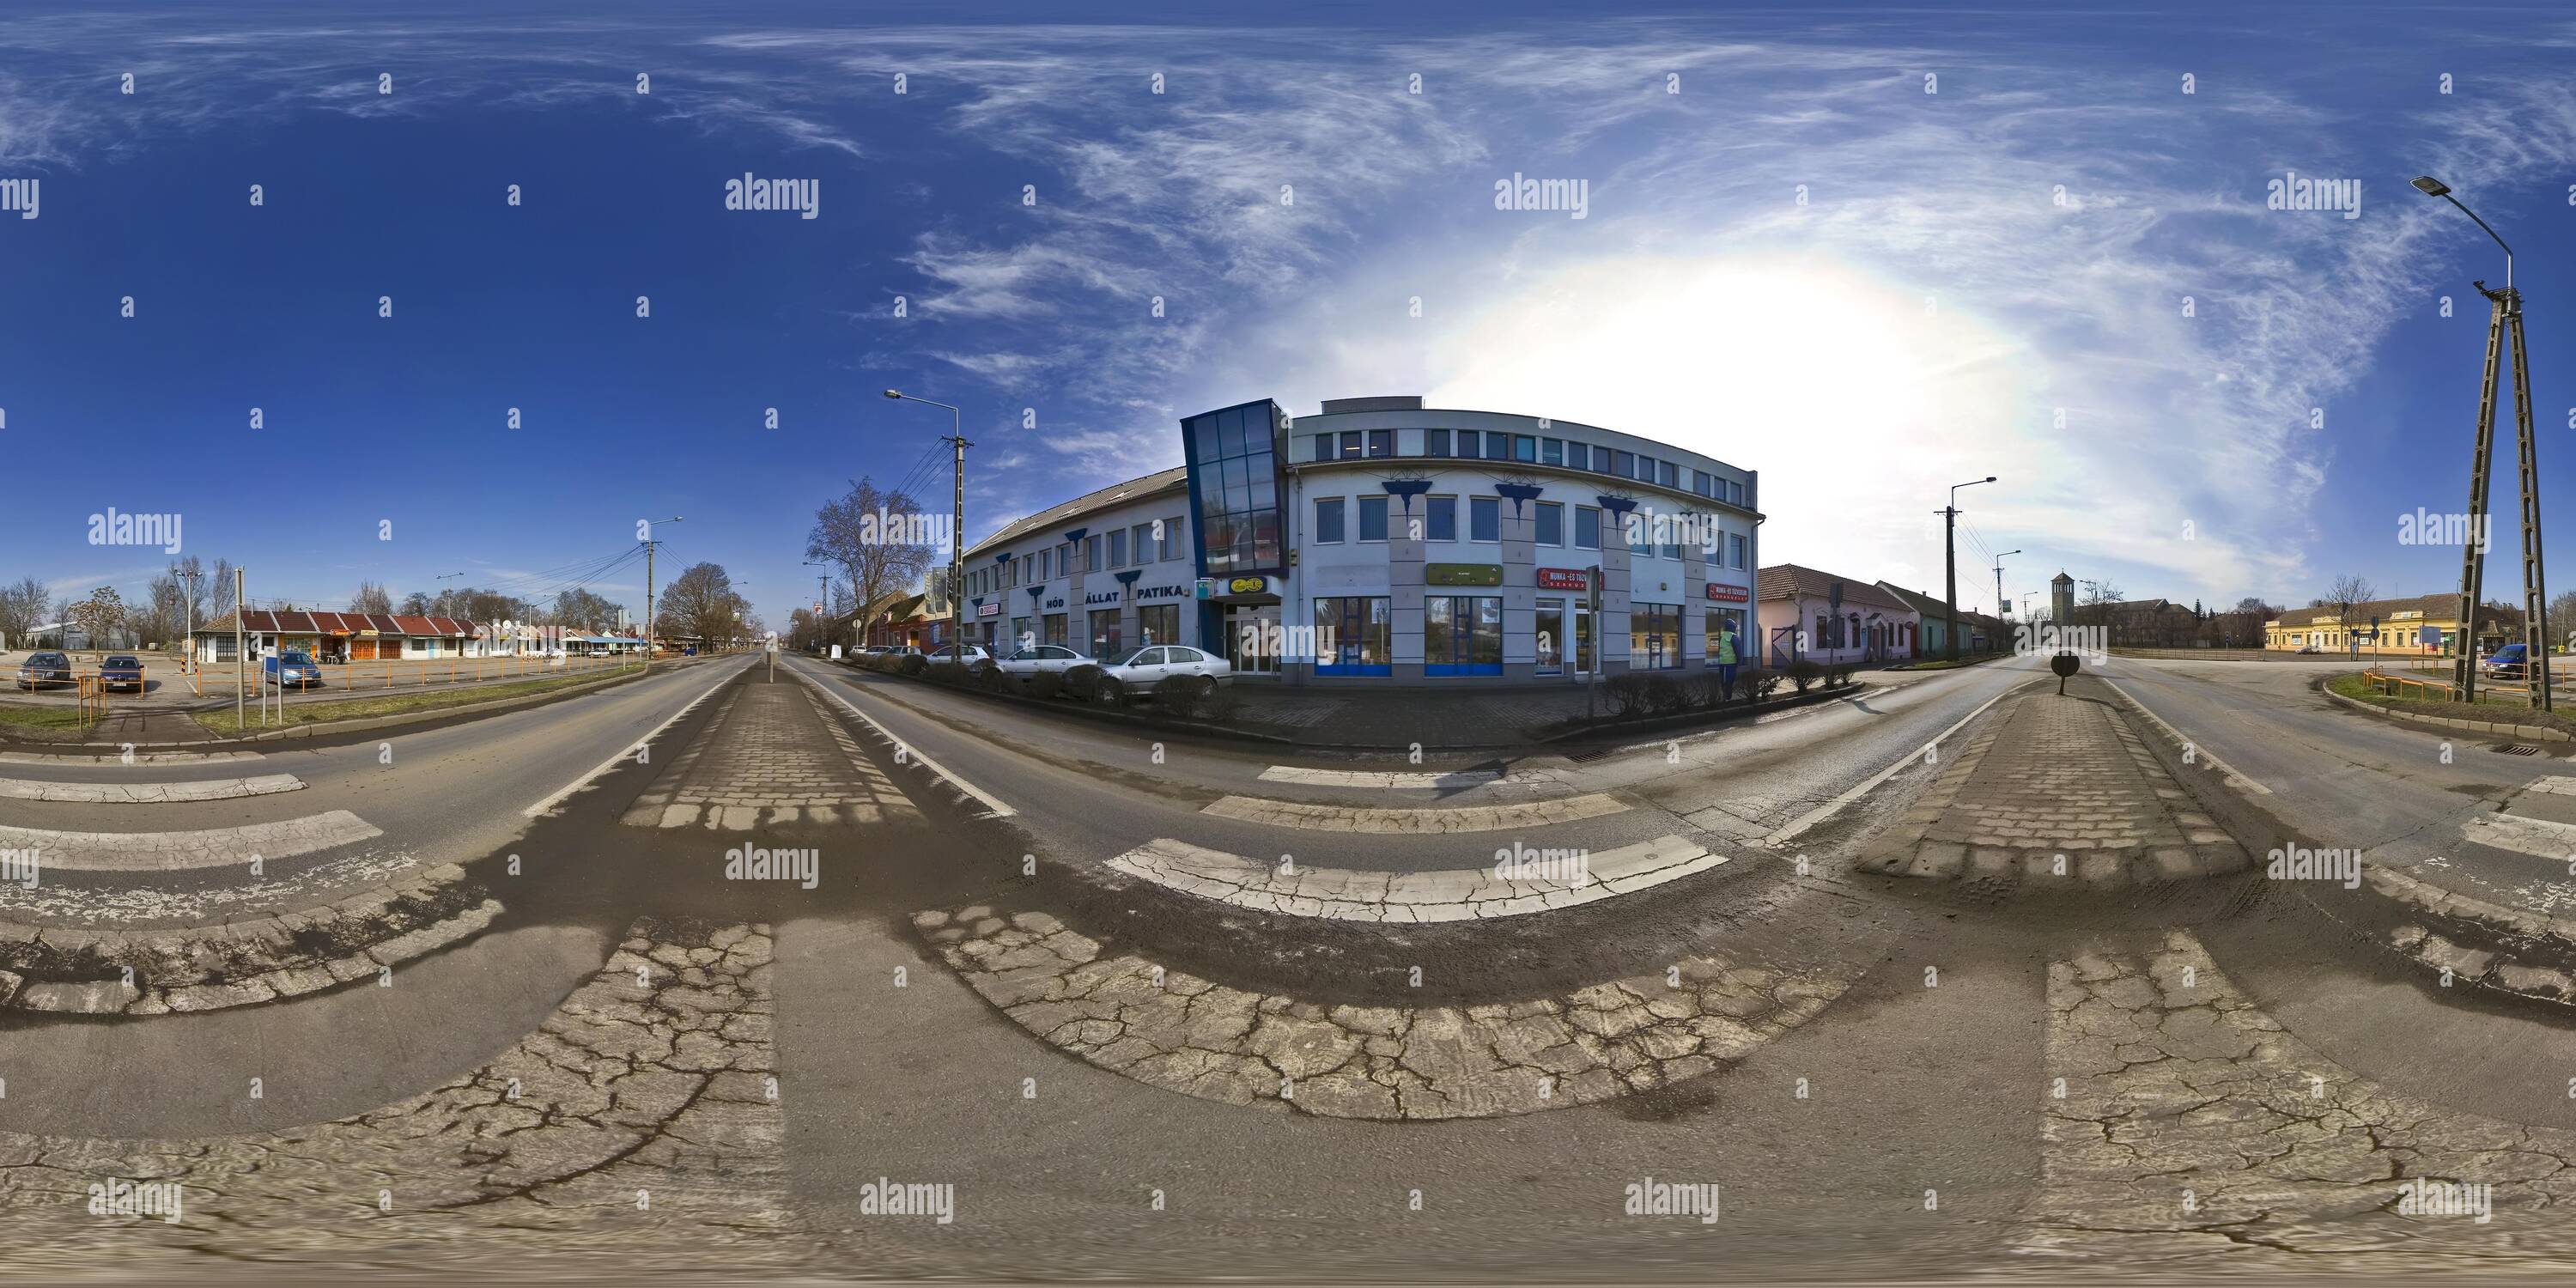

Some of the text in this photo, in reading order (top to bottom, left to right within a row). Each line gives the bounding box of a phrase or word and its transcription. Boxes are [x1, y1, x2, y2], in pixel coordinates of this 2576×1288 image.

[1550, 572, 1565, 580] MUNKA
[1046, 596, 1064, 609] HÓD
[1085, 592, 1119, 605] ÁLLAT
[1137, 585, 1183, 599] PATIKA
